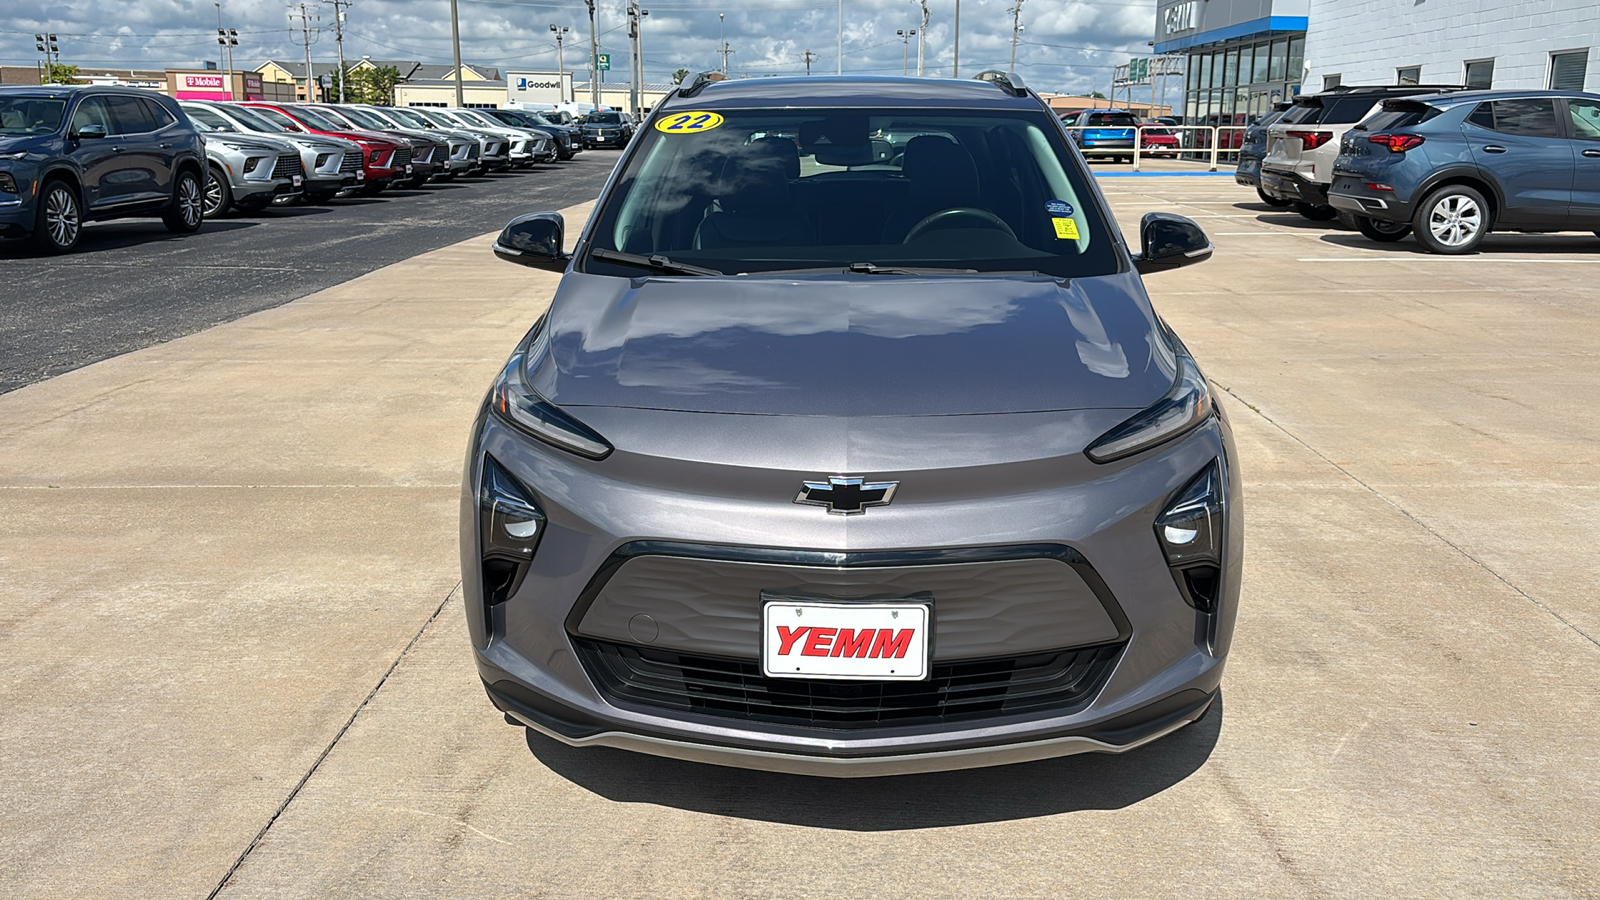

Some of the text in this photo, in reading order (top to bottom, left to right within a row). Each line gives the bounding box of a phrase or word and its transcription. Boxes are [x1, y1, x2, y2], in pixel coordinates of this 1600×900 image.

[194, 77, 220, 86] Mobile
[527, 80, 562, 89] Goodwil
[667, 114, 711, 130] 22
[776, 626, 915, 658] YEMM
